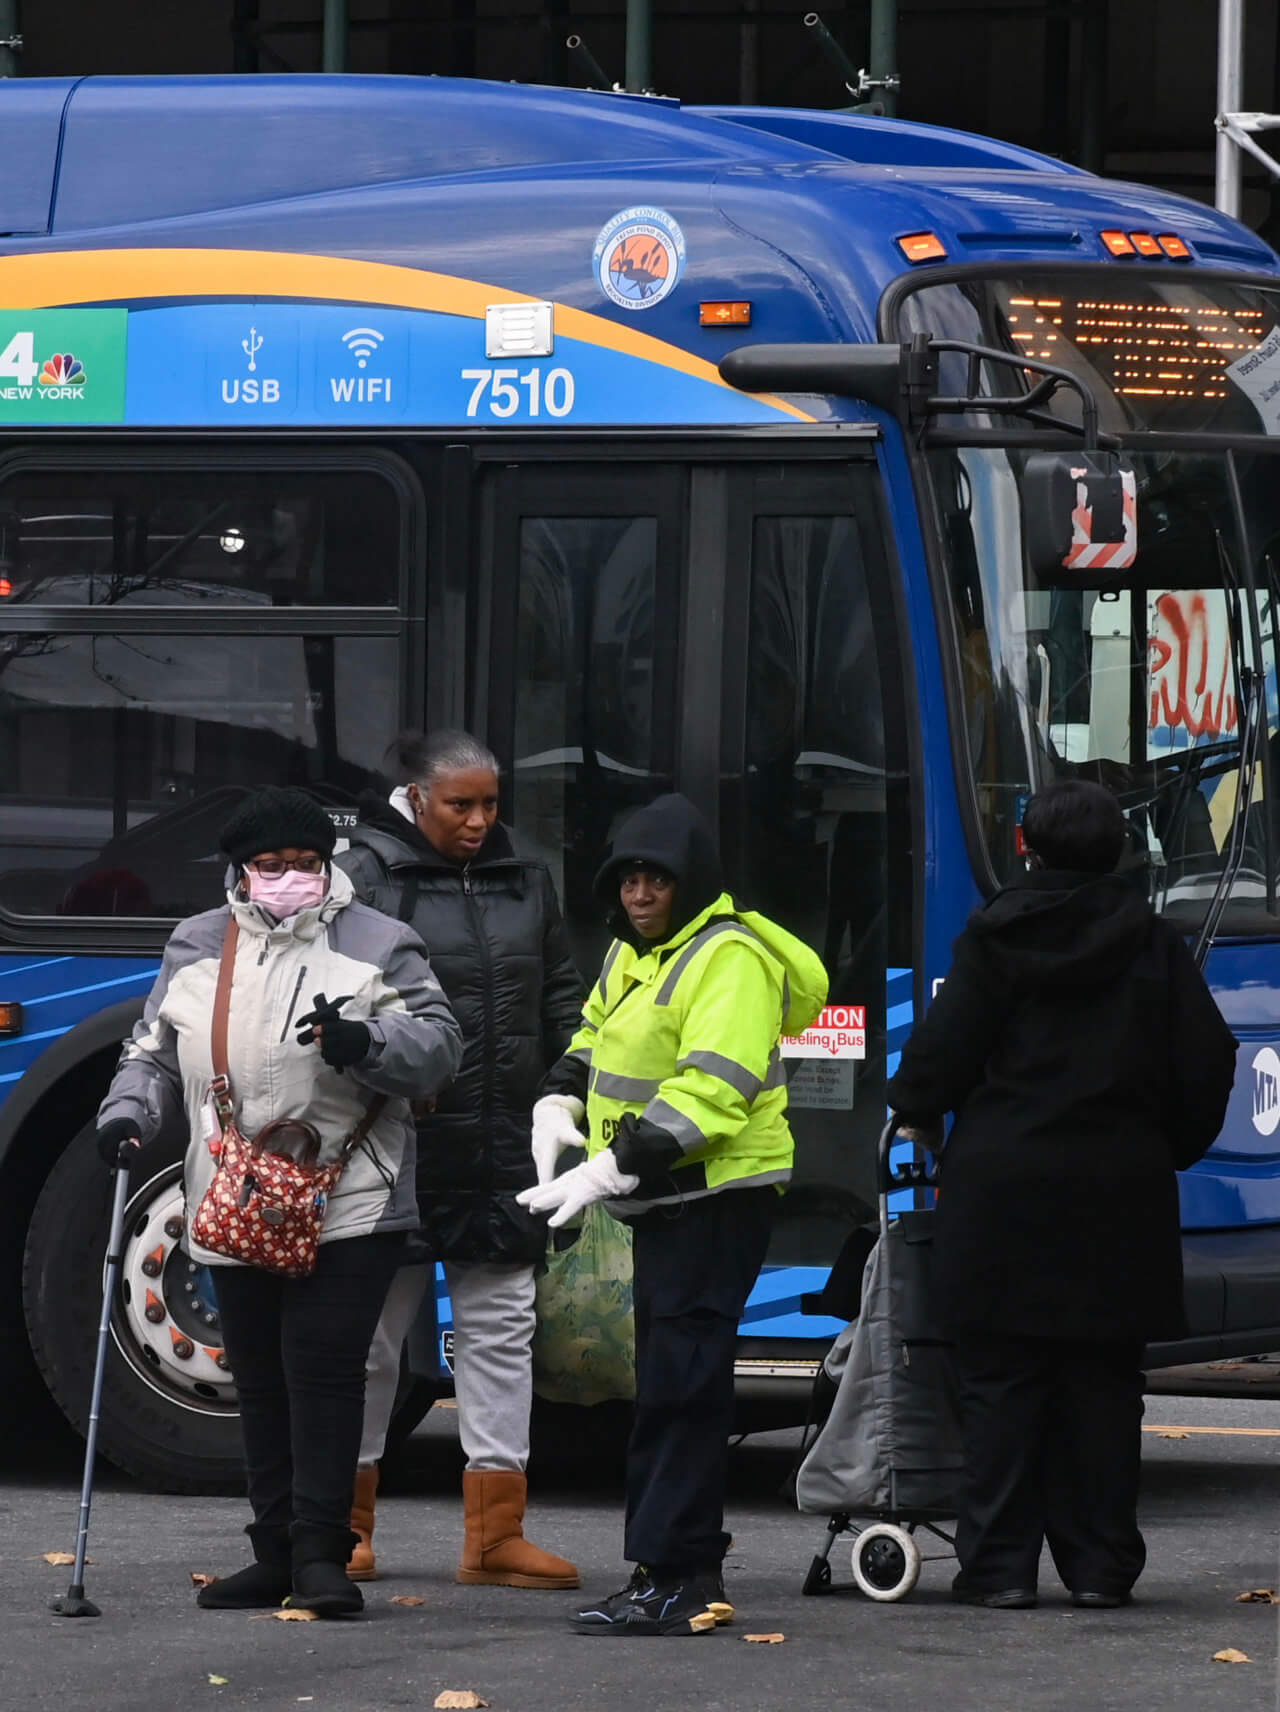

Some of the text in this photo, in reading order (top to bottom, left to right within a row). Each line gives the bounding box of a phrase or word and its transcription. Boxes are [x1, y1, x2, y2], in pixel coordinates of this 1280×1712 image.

[36, 387, 85, 400] YORK
[221, 379, 281, 404] USB
[330, 379, 392, 403] WIFI
[460, 367, 575, 418] 7510
[818, 1007, 864, 1028] TION
[781, 1032, 864, 1049] neeling Bus
[1253, 1067, 1278, 1115] MTA
